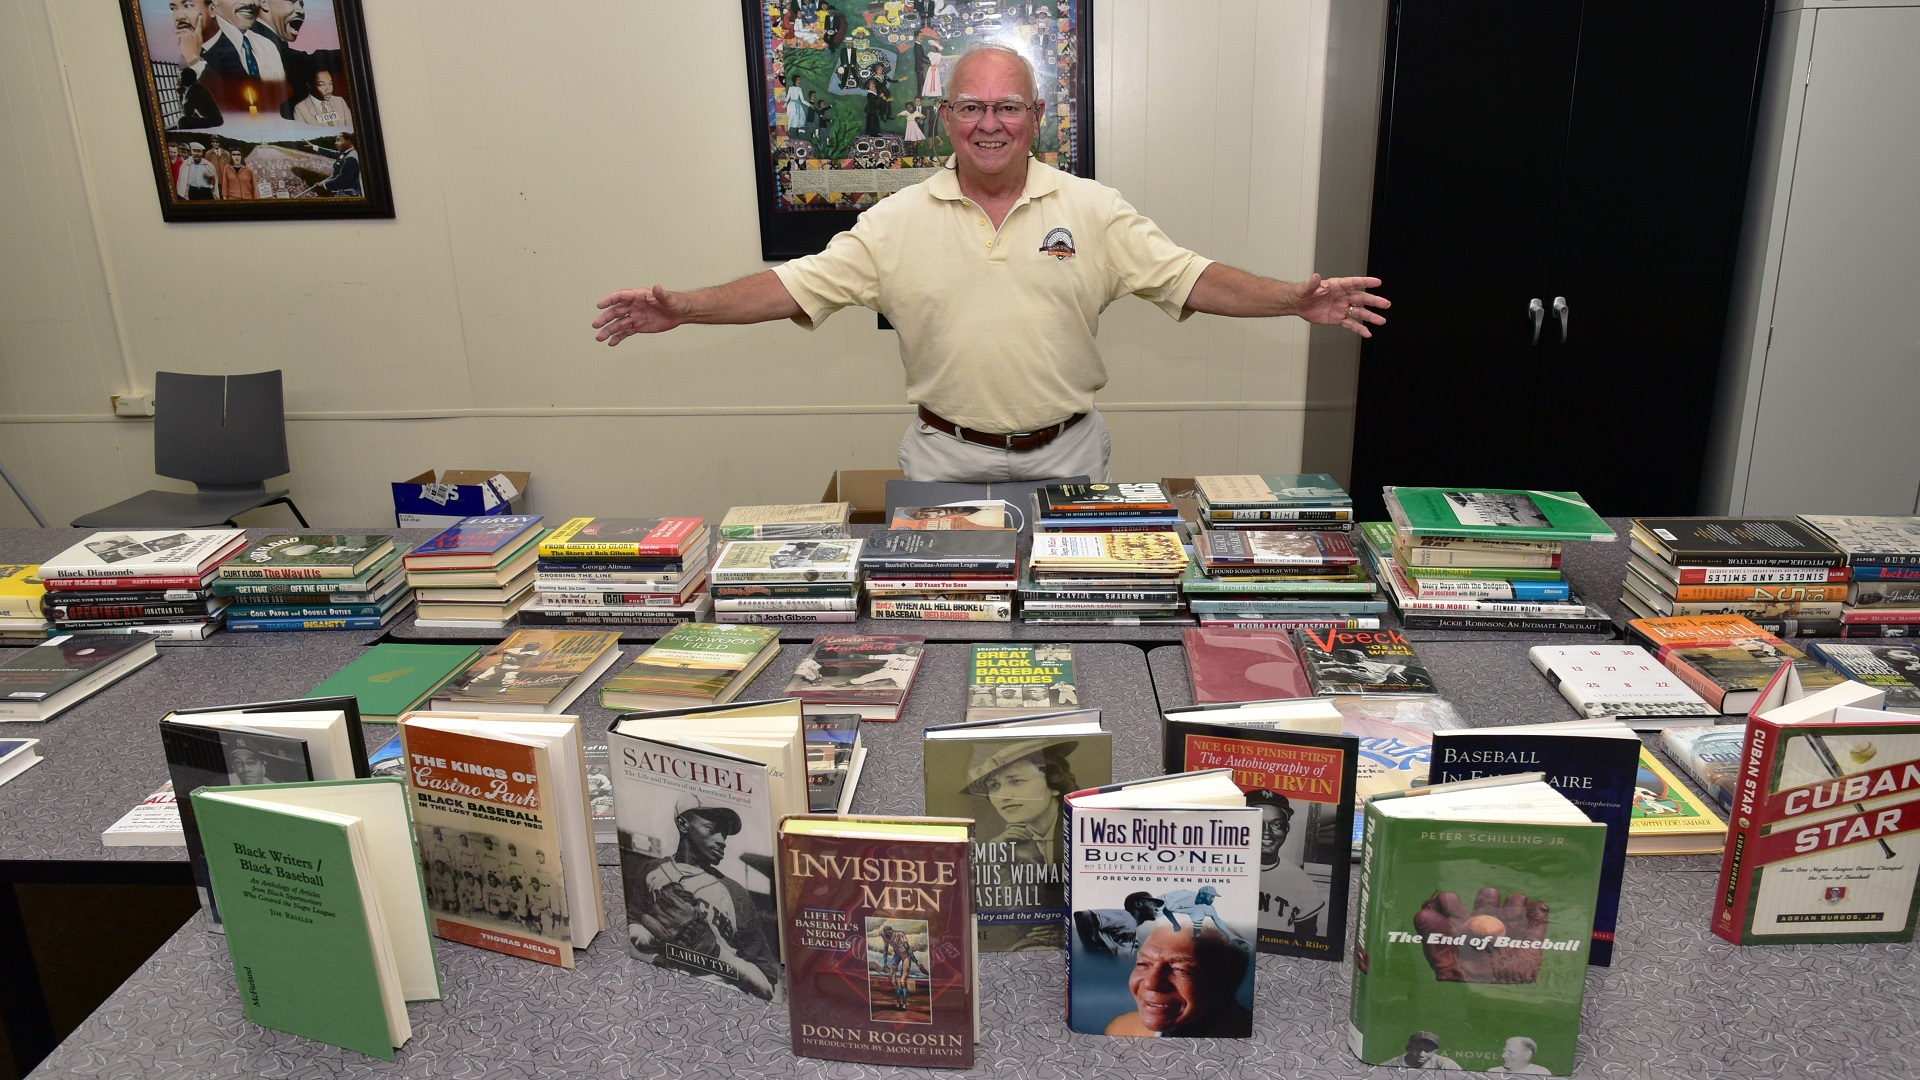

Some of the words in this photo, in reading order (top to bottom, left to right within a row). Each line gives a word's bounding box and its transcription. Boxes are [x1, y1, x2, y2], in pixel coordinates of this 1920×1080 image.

[319, 113, 337, 121] 7089
[1236, 511, 1258, 519] PAST
[1274, 511, 1296, 519] TIME
[1884, 556, 1906, 564] OUT
[58, 569, 84, 578] Black
[87, 568, 134, 577] Diamonds
[224, 570, 241, 578] CURT
[242, 570, 263, 578] FLOOD
[263, 569, 280, 578] The
[281, 569, 302, 579] Way
[304, 569, 311, 578] It
[312, 569, 321, 578] Is
[1708, 574, 1747, 582] SMILES
[1752, 574, 1773, 582] AND
[1778, 574, 1824, 582] SINGLES
[1422, 582, 1438, 590] Glory
[1440, 582, 1455, 590] Days
[1483, 583, 1509, 591] Dodgers
[896, 602, 916, 610] WHEN
[918, 602, 933, 610] ALL
[934, 602, 952, 610] HELL
[953, 602, 976, 610] BROKE
[941, 612, 970, 620] BARBER
[1643, 617, 1683, 629] Negro
[1438, 620, 1462, 628] JACKIE
[1464, 620, 1507, 628] ROBINSON:
[1559, 622, 1597, 630] PORTRAIT
[1651, 624, 1755, 642] Baseball
[671, 634, 756, 649] RICKWOOD
[683, 642, 729, 651] FIELD
[826, 643, 897, 653] Hardball
[1306, 628, 1411, 653] Veeck
[976, 651, 1030, 660] GREAT
[976, 660, 1032, 668] BLACK
[976, 668, 1063, 677] BASEBALL
[976, 675, 1053, 685] LEAGUES
[1193, 740, 1221, 754] NICE
[1223, 744, 1254, 758] GUYS
[1256, 747, 1297, 762] FINISH
[1300, 751, 1337, 766] FIRST
[1444, 748, 1541, 764] BASEBALL
[1747, 729, 1767, 778] CUBAN
[411, 753, 447, 769] THE
[451, 761, 508, 782] KINGS
[512, 771, 538, 786] OF
[622, 746, 753, 795] SATCHEL
[1199, 751, 1222, 768] The
[1225, 755, 1310, 780] Autobiography
[1313, 764, 1328, 781] of
[412, 767, 481, 798] Casino
[485, 778, 539, 808] Park
[1273, 774, 1335, 795] IRVIN
[1784, 764, 1920, 816] CUBAN
[1741, 779, 1757, 815] STAR
[418, 792, 463, 809] BLACK
[467, 802, 544, 823] BASEBALL
[1080, 817, 1085, 844] I
[1090, 818, 1127, 845] Was
[1133, 818, 1178, 851] Right
[1182, 824, 1204, 846] on
[1209, 819, 1251, 847] Time
[1794, 808, 1902, 853] STAR
[1421, 832, 1462, 841] PETER
[1469, 834, 1543, 845] SCHILLING
[1549, 836, 1569, 846] JR.
[233, 842, 267, 860] Black
[269, 850, 313, 870] Writers
[974, 842, 1018, 866] MOST
[1085, 849, 1150, 863] BUCK
[1157, 850, 1246, 866] O'NEIL
[239, 858, 273, 876] Black
[275, 866, 325, 887] Baseball
[789, 848, 958, 885] INVISIBLE
[860, 885, 943, 912] MEN
[804, 912, 829, 921] LIFE
[833, 913, 846, 921] IN
[795, 920, 859, 932] BASEBALL'S
[806, 930, 846, 940] NEGRO
[1260, 934, 1289, 946] James
[1292, 938, 1303, 948] A.
[1305, 939, 1331, 952] Riley
[1388, 931, 1424, 945] The
[1427, 933, 1467, 946] End
[1470, 936, 1493, 952] of
[1493, 936, 1581, 953] Baseball
[480, 932, 520, 948] THOMAS
[523, 942, 557, 958] AIELLO
[801, 938, 851, 950] LEAGUES
[671, 947, 709, 970] LARRY
[710, 958, 734, 976] TYE
[244, 966, 261, 1008] McFarland
[802, 1024, 862, 1045] DONN
[869, 1032, 963, 1047] ROGOSIN
